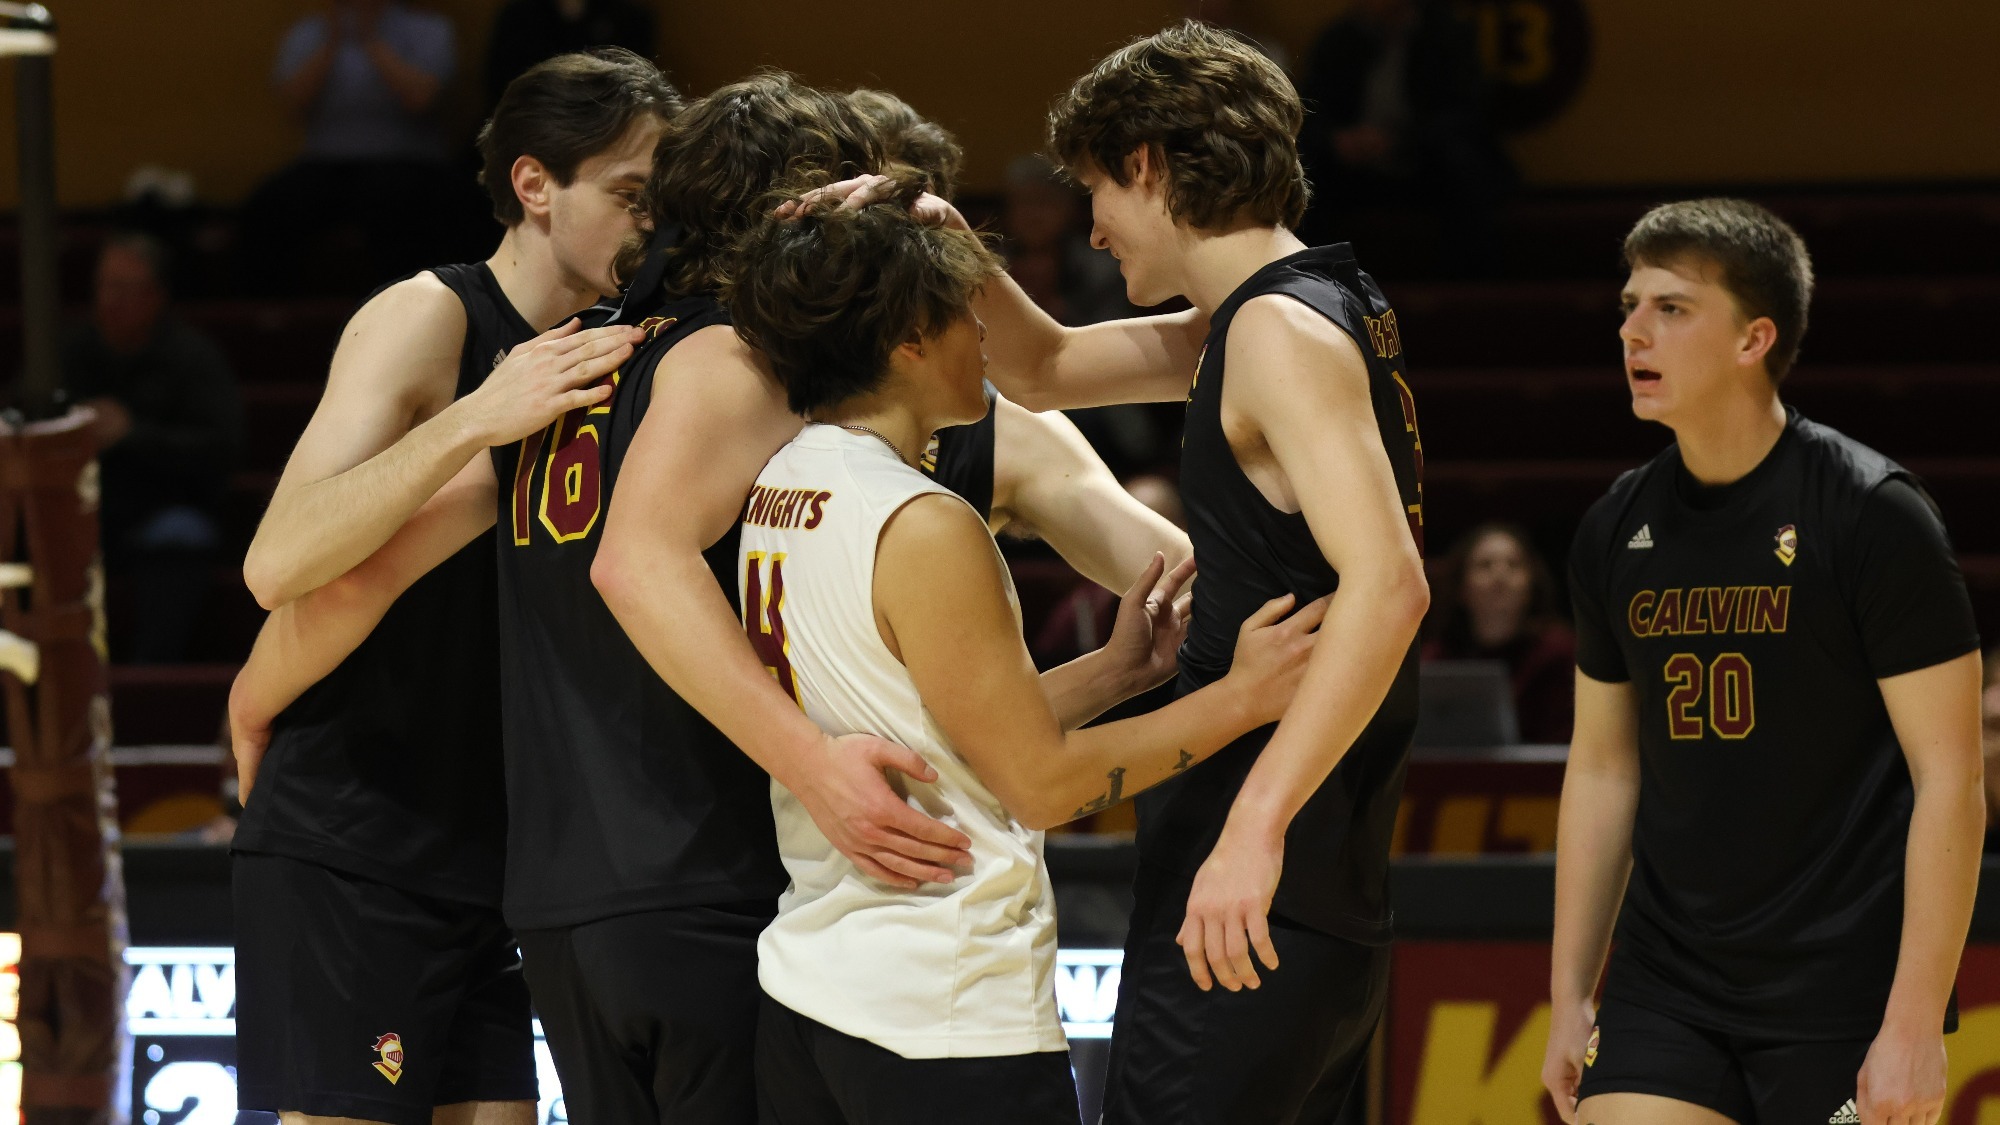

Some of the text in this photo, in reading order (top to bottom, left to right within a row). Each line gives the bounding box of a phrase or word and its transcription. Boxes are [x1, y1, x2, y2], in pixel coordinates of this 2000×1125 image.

[744, 550, 807, 715] 4
[1628, 585, 1792, 638] CALVIN
[1664, 652, 1755, 740] 20
[1828, 1113, 1860, 1124] adida
